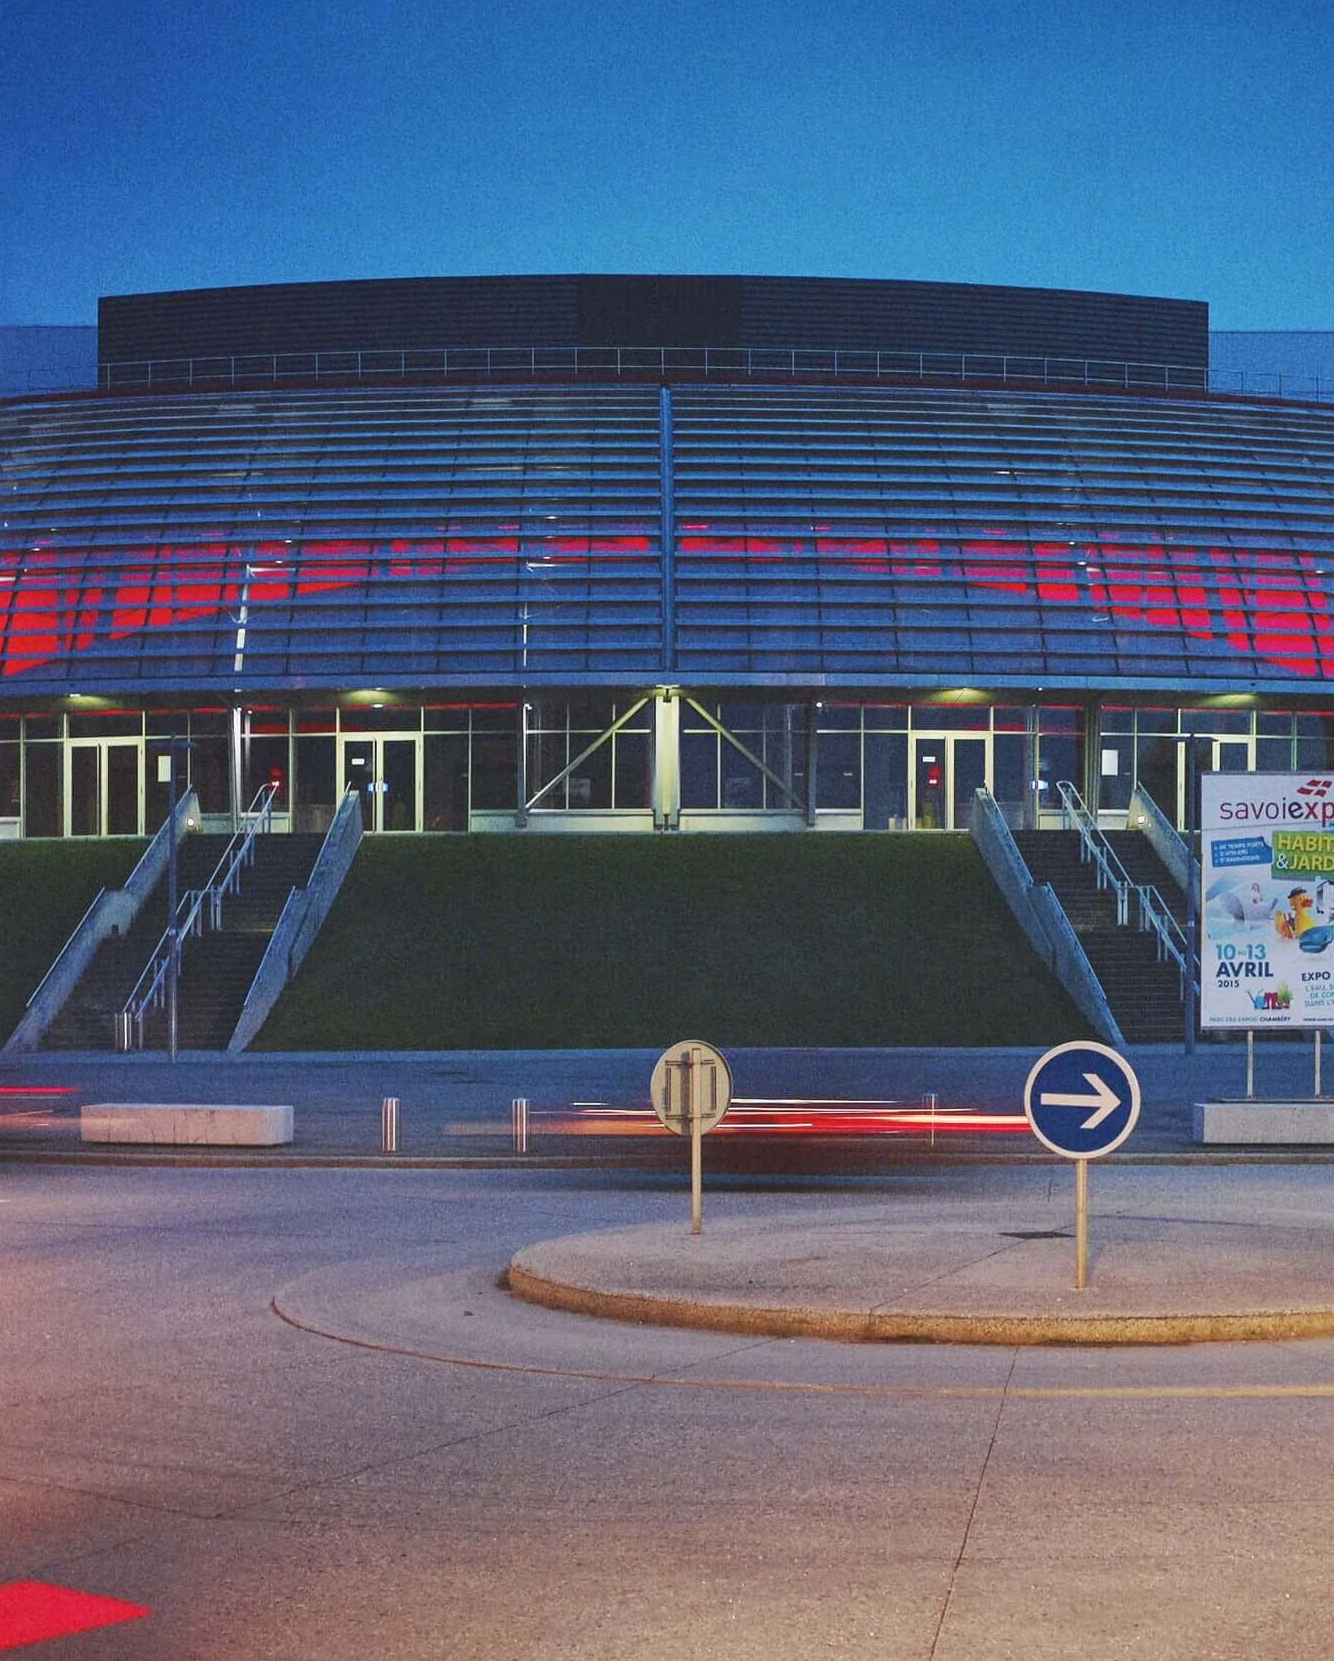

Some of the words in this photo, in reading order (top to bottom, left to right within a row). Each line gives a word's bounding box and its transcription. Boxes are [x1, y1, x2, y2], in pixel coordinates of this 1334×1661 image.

[1215, 943, 1236, 960] 10
[1246, 943, 1266, 960] 13
[1215, 961, 1274, 978] AVRIL
[1301, 971, 1331, 981] EXPO
[1218, 979, 1240, 988] 2015
